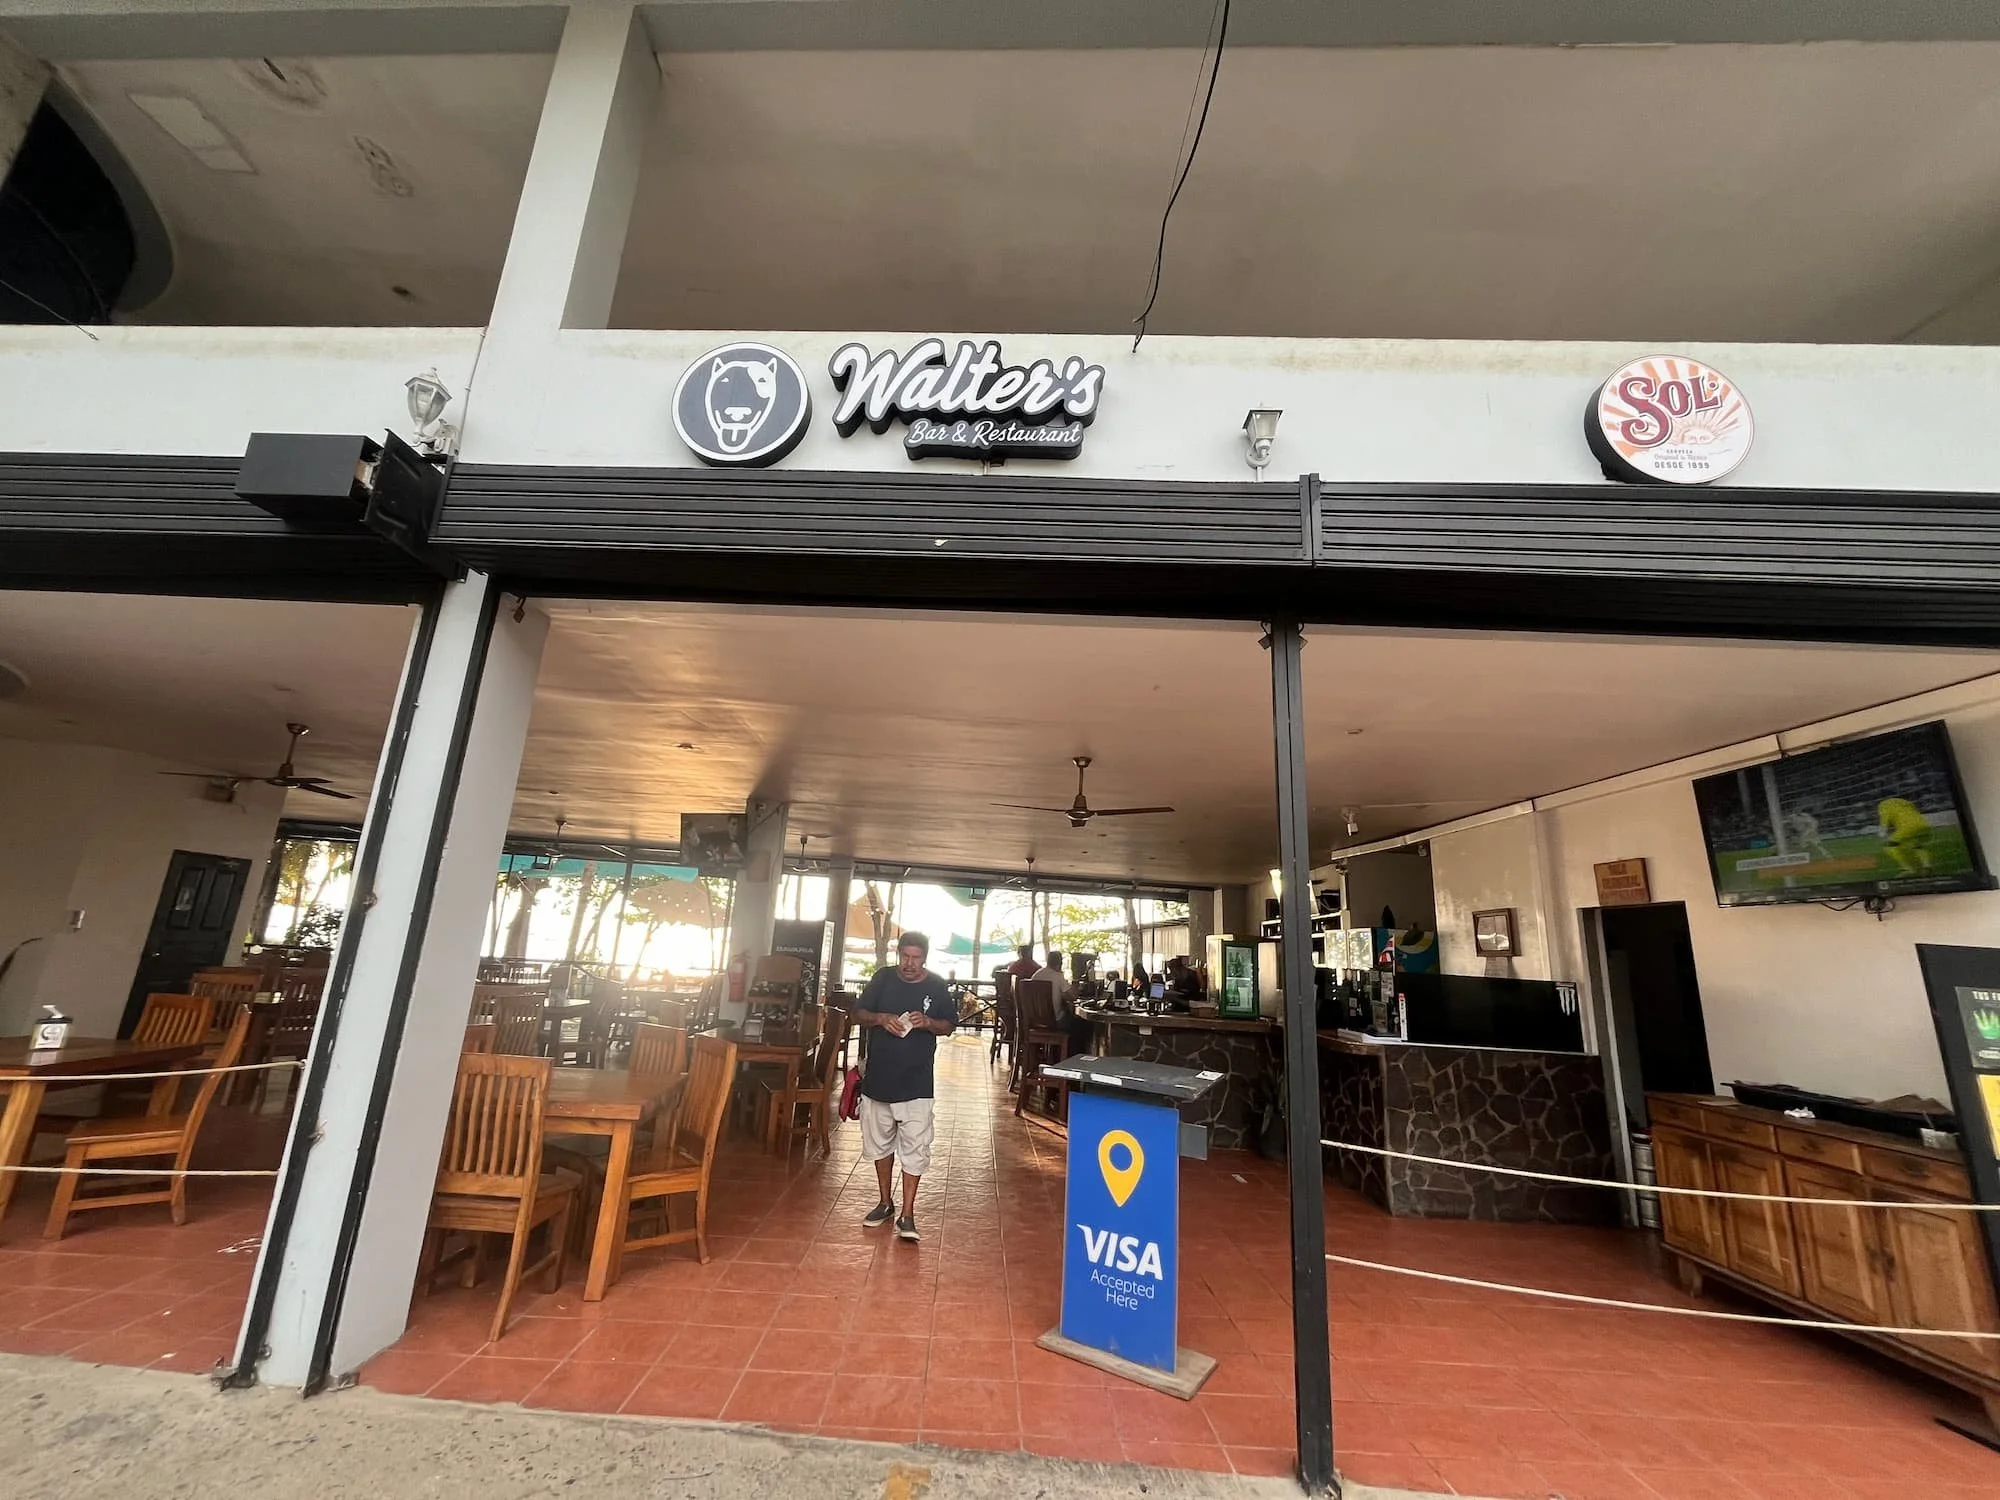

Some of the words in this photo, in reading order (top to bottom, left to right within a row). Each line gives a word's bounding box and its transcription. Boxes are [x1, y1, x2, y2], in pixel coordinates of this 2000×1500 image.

[831, 339, 1103, 423] Walter's
[908, 420, 949, 443] Bar
[951, 423, 967, 442] &
[972, 420, 1081, 446] Restaurant
[1654, 461, 1684, 469] DESDE
[1076, 1223, 1164, 1281] VISA
[1090, 1268, 1155, 1299] Accepted
[1105, 1289, 1138, 1311] Here
